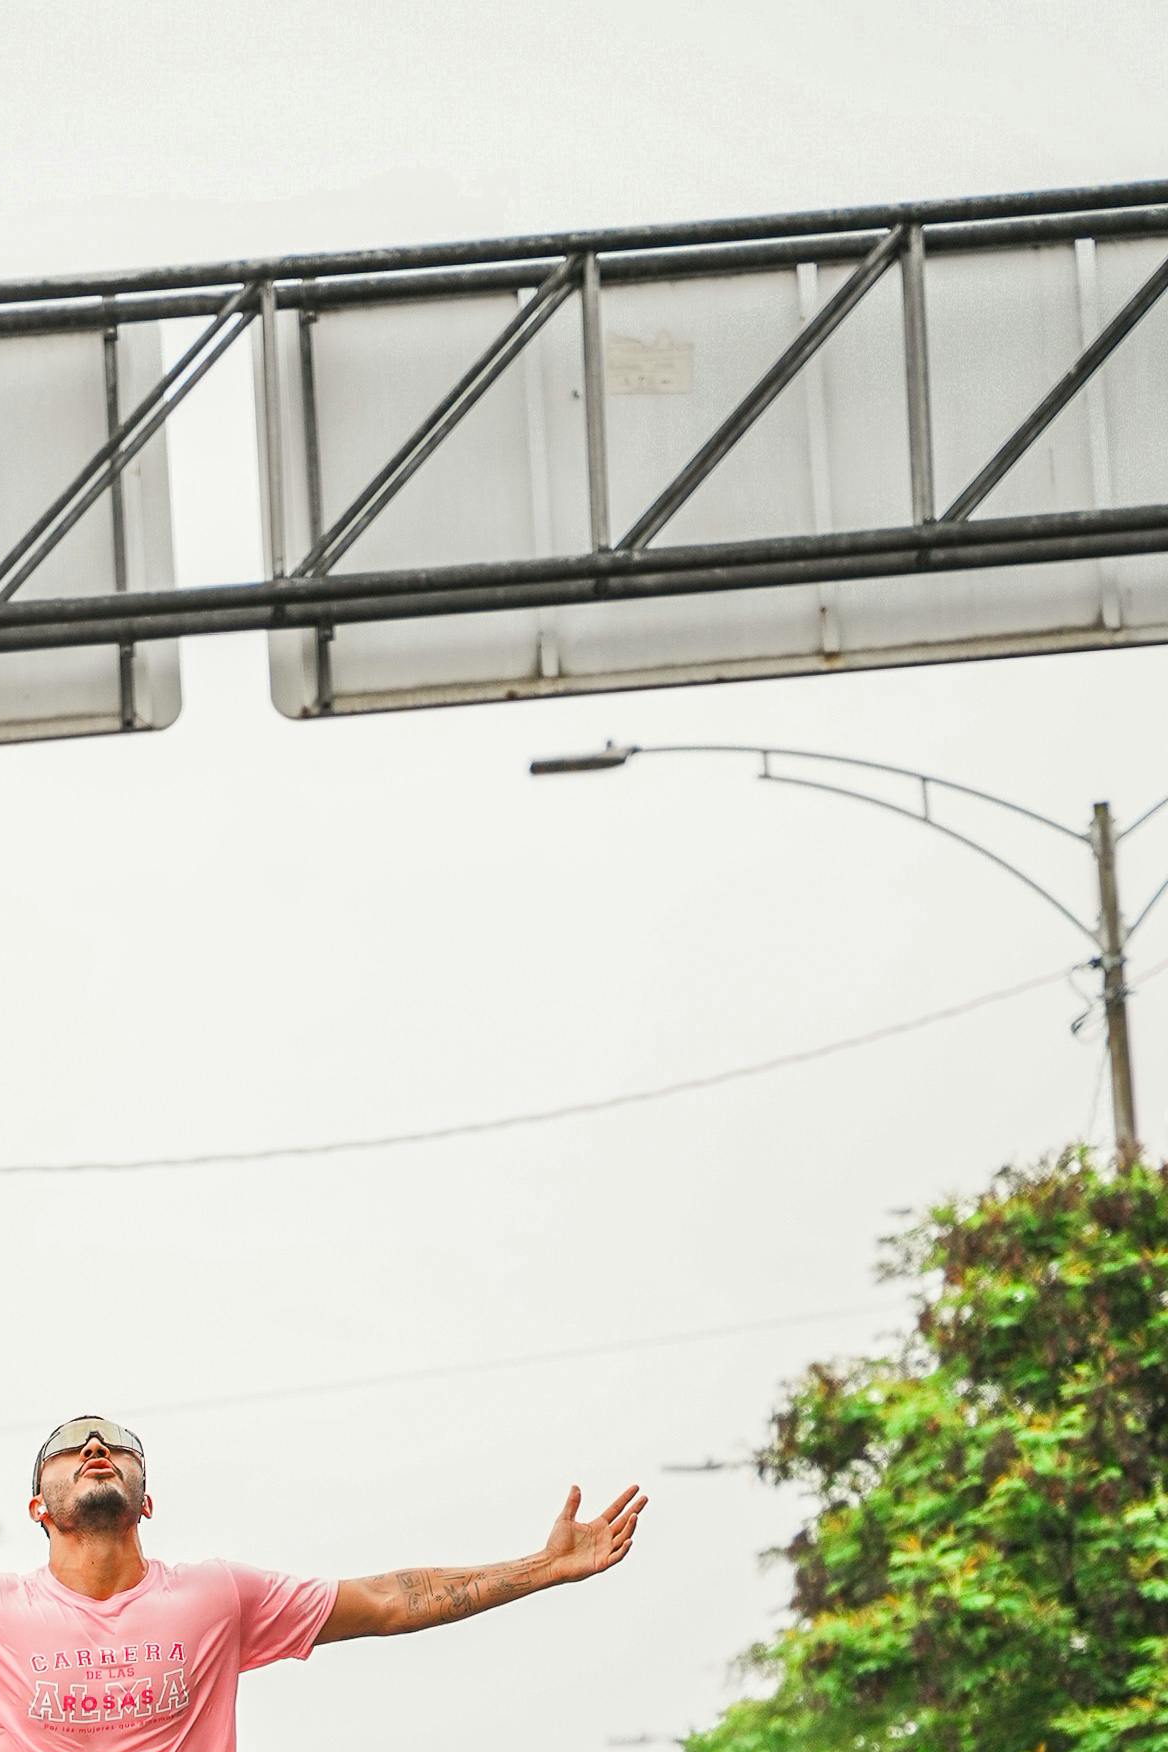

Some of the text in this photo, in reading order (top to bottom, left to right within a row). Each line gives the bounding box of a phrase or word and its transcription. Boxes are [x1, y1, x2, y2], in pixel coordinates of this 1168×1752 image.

[30, 1641, 187, 1673] CARRERA
[86, 1667, 135, 1680] DE LAS
[28, 1668, 190, 1723] ALMA
[62, 1688, 154, 1713] ROSAS
